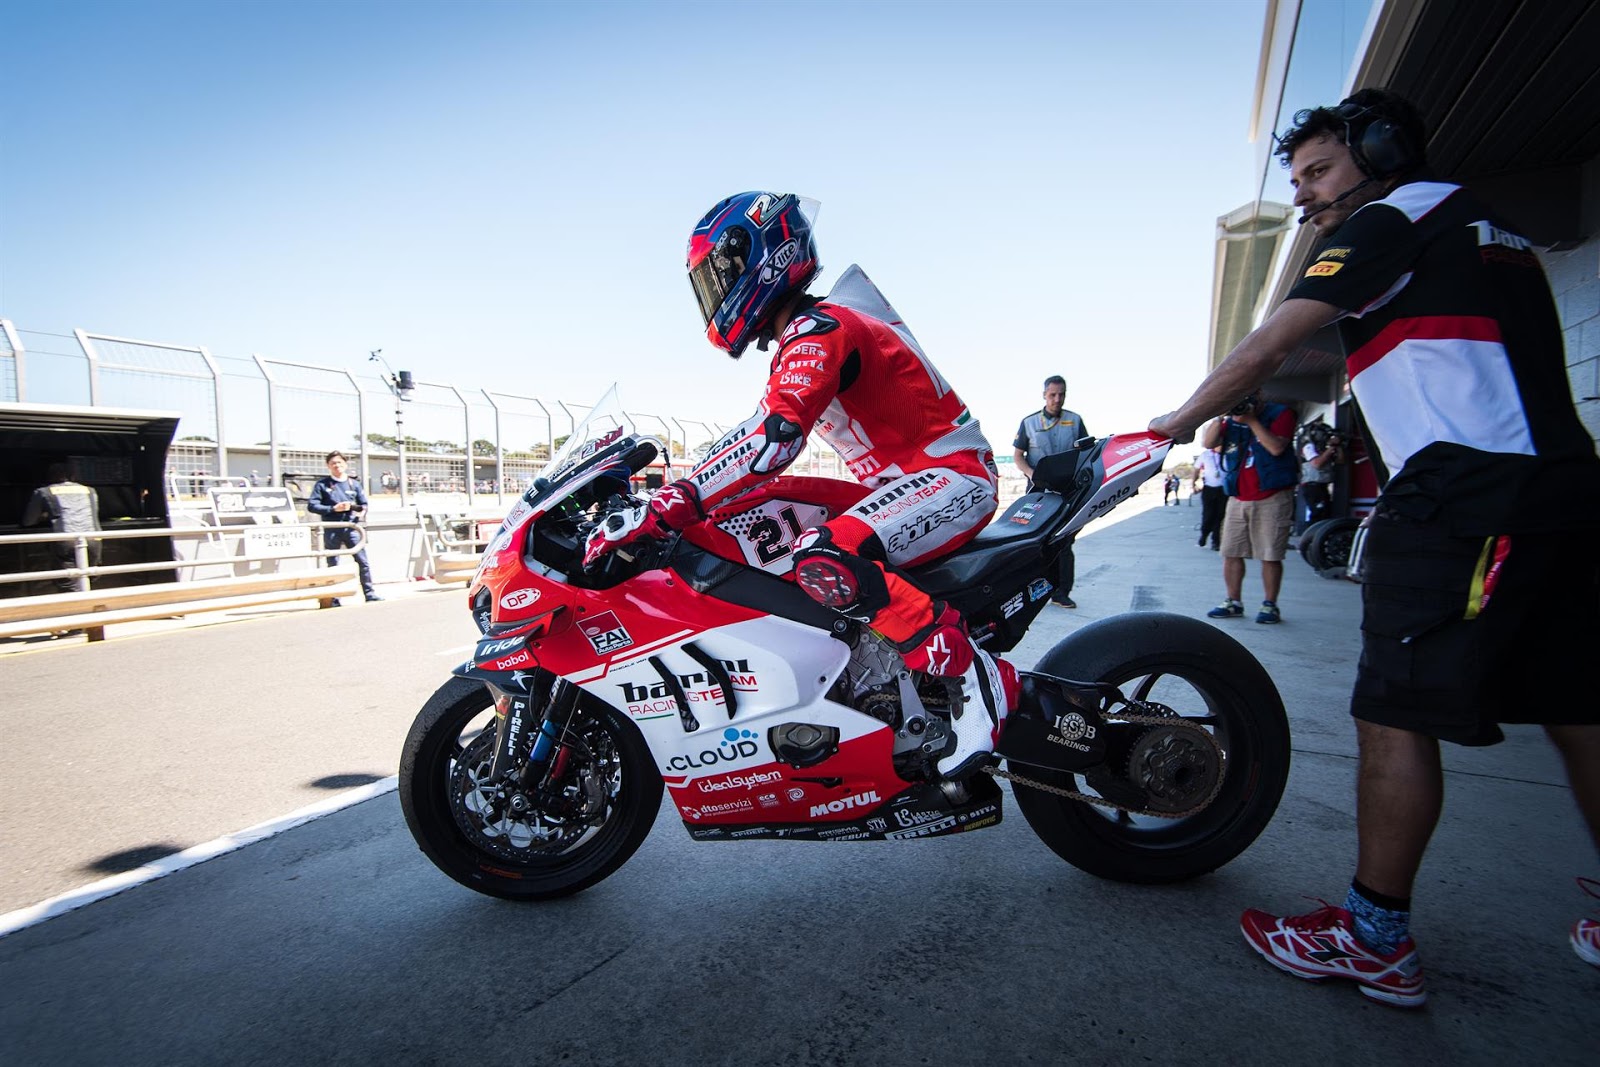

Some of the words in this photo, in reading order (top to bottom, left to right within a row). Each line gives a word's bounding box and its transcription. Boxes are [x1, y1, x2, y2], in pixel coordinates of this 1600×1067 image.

[765, 244, 796, 281] X-lite
[692, 427, 746, 472] DUCATI
[696, 442, 756, 485] barni
[847, 455, 881, 478] CATI
[854, 472, 940, 516] barni
[888, 486, 989, 553] alpinestars
[251, 531, 304, 540] PROHIBITED
[747, 504, 805, 567] 21
[507, 593, 528, 607] DP
[591, 628, 628, 648] FAI
[496, 651, 529, 670] babol
[615, 659, 756, 703] barni
[508, 701, 525, 756] PIRELLI
[1046, 734, 1091, 752] BEARINGS
[810, 790, 881, 818] MOTUL
[866, 818, 888, 830] STM
[884, 815, 957, 840] PIRELLI
